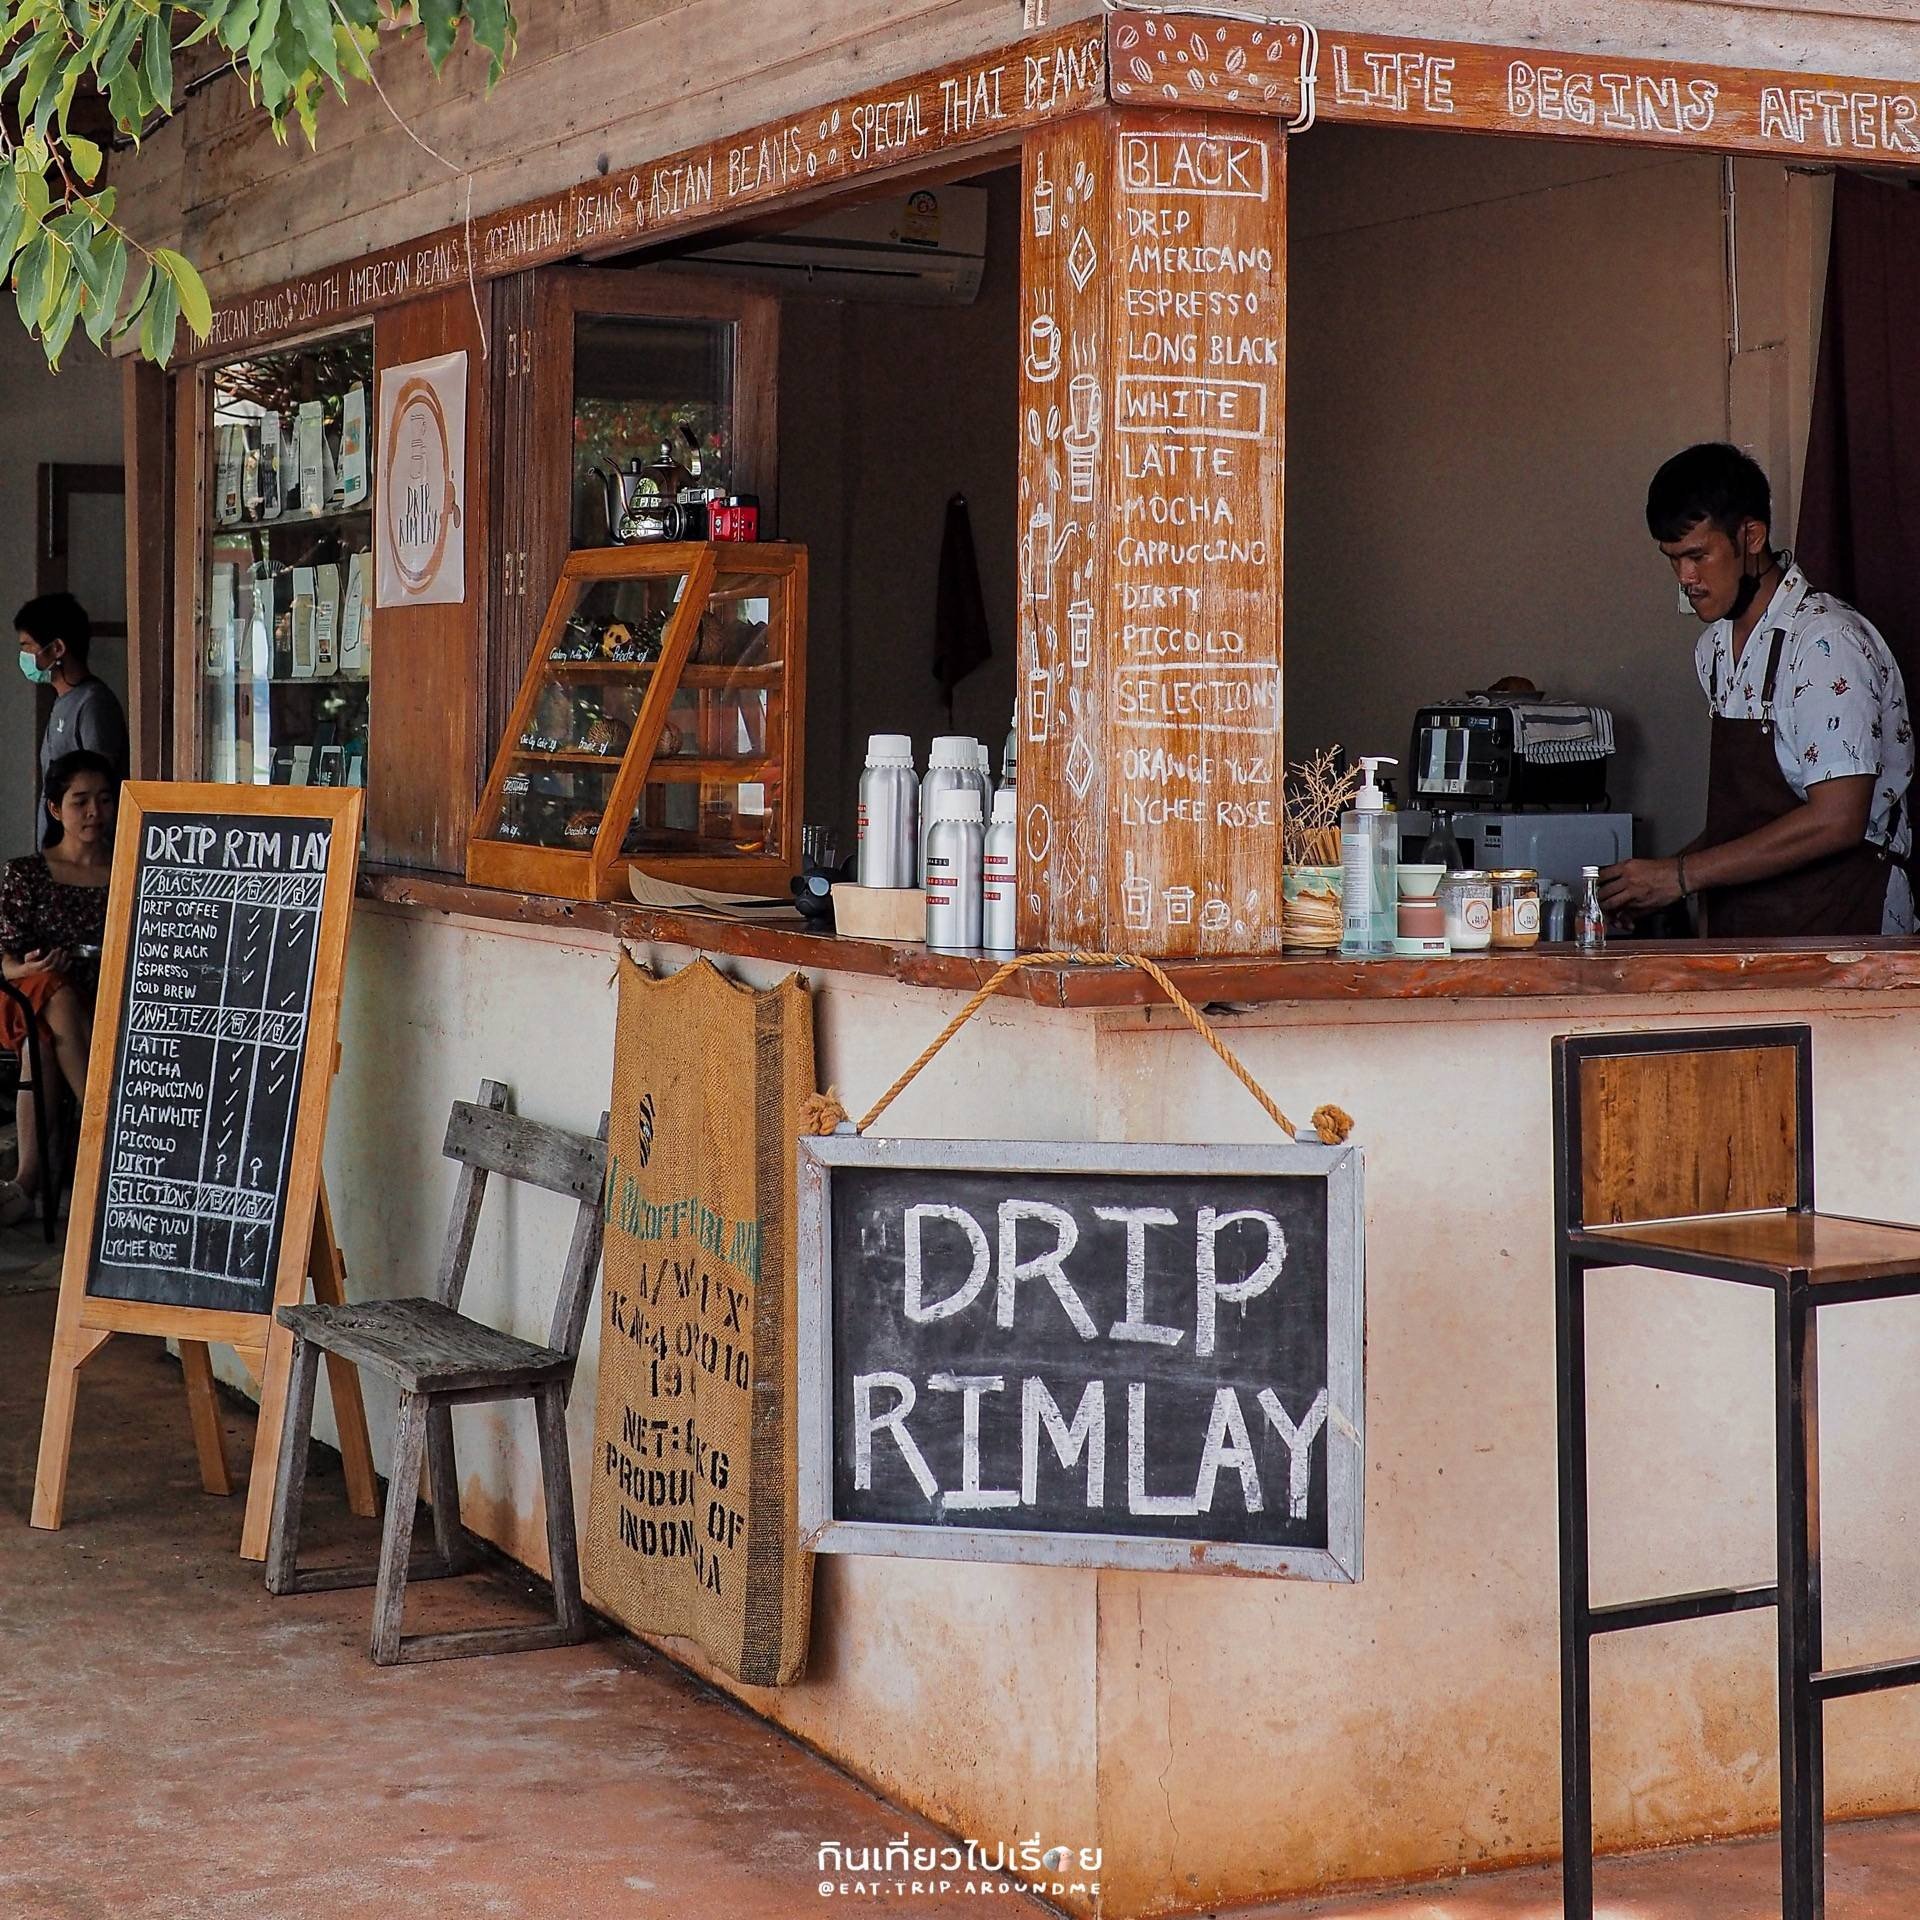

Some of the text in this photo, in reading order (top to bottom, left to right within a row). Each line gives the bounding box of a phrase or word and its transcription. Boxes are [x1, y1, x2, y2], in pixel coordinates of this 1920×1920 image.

[1332, 45, 1920, 153] LIFE BEGINS AFTER
[1127, 139, 1251, 188] BLACK
[206, 305, 249, 347] FRICAN
[253, 294, 284, 334] BEANS
[299, 272, 340, 320] SOUTH
[348, 254, 410, 307] AMERICAN
[416, 239, 460, 287] BEANS
[484, 201, 563, 263] OCEANIAN
[576, 187, 623, 238] BEANS
[650, 157, 712, 220] ASIAN
[728, 126, 801, 196] BEANS
[851, 94, 928, 160] SPECIAL
[940, 66, 1007, 136] THAI
[1023, 38, 1101, 111] BEANS
[1127, 208, 1190, 239] DRIP
[1128, 245, 1271, 274] AMERICANO
[1127, 289, 1258, 318] ESPRESSO
[1129, 331, 1277, 366] LONG BLACK
[1126, 390, 1239, 419] WHITE
[1124, 443, 1234, 478] LATTE
[1122, 496, 1234, 525] MOCHA
[1118, 537, 1266, 568] CAPPUCCINO
[1122, 584, 1201, 612] DIRTY
[1123, 625, 1244, 656] PICCOLO
[1119, 680, 1278, 715] SELECTIONS
[1123, 749, 1213, 785] ORANGE
[1123, 793, 1275, 828] LYCHEE ROSE
[145, 825, 217, 864] DRIP
[222, 829, 281, 868] RIM
[157, 875, 202, 893] BLACK
[143, 901, 220, 919] DRIP COFFEE
[141, 921, 218, 939] AMERICANO
[139, 943, 209, 959] LONG BLACK
[137, 962, 189, 978] ESPRESSO
[135, 981, 197, 999] COLD BREW
[144, 1006, 201, 1027] WHITE
[131, 1037, 182, 1058] LATTE
[128, 1059, 182, 1079] MOCHA
[125, 1081, 204, 1100] CAPPUCCINO
[119, 1130, 176, 1152] PICCOLO
[115, 1151, 166, 1176] DIRTY
[109, 1178, 192, 1209] SELECTIONS
[108, 1210, 189, 1235] ORANGE YUZU
[106, 1239, 177, 1261] LYCHEE ROSE
[904, 1199, 1288, 1357] DRIP
[854, 1371, 1329, 1520] RIMLAY
[708, 1501, 745, 1549] OF
